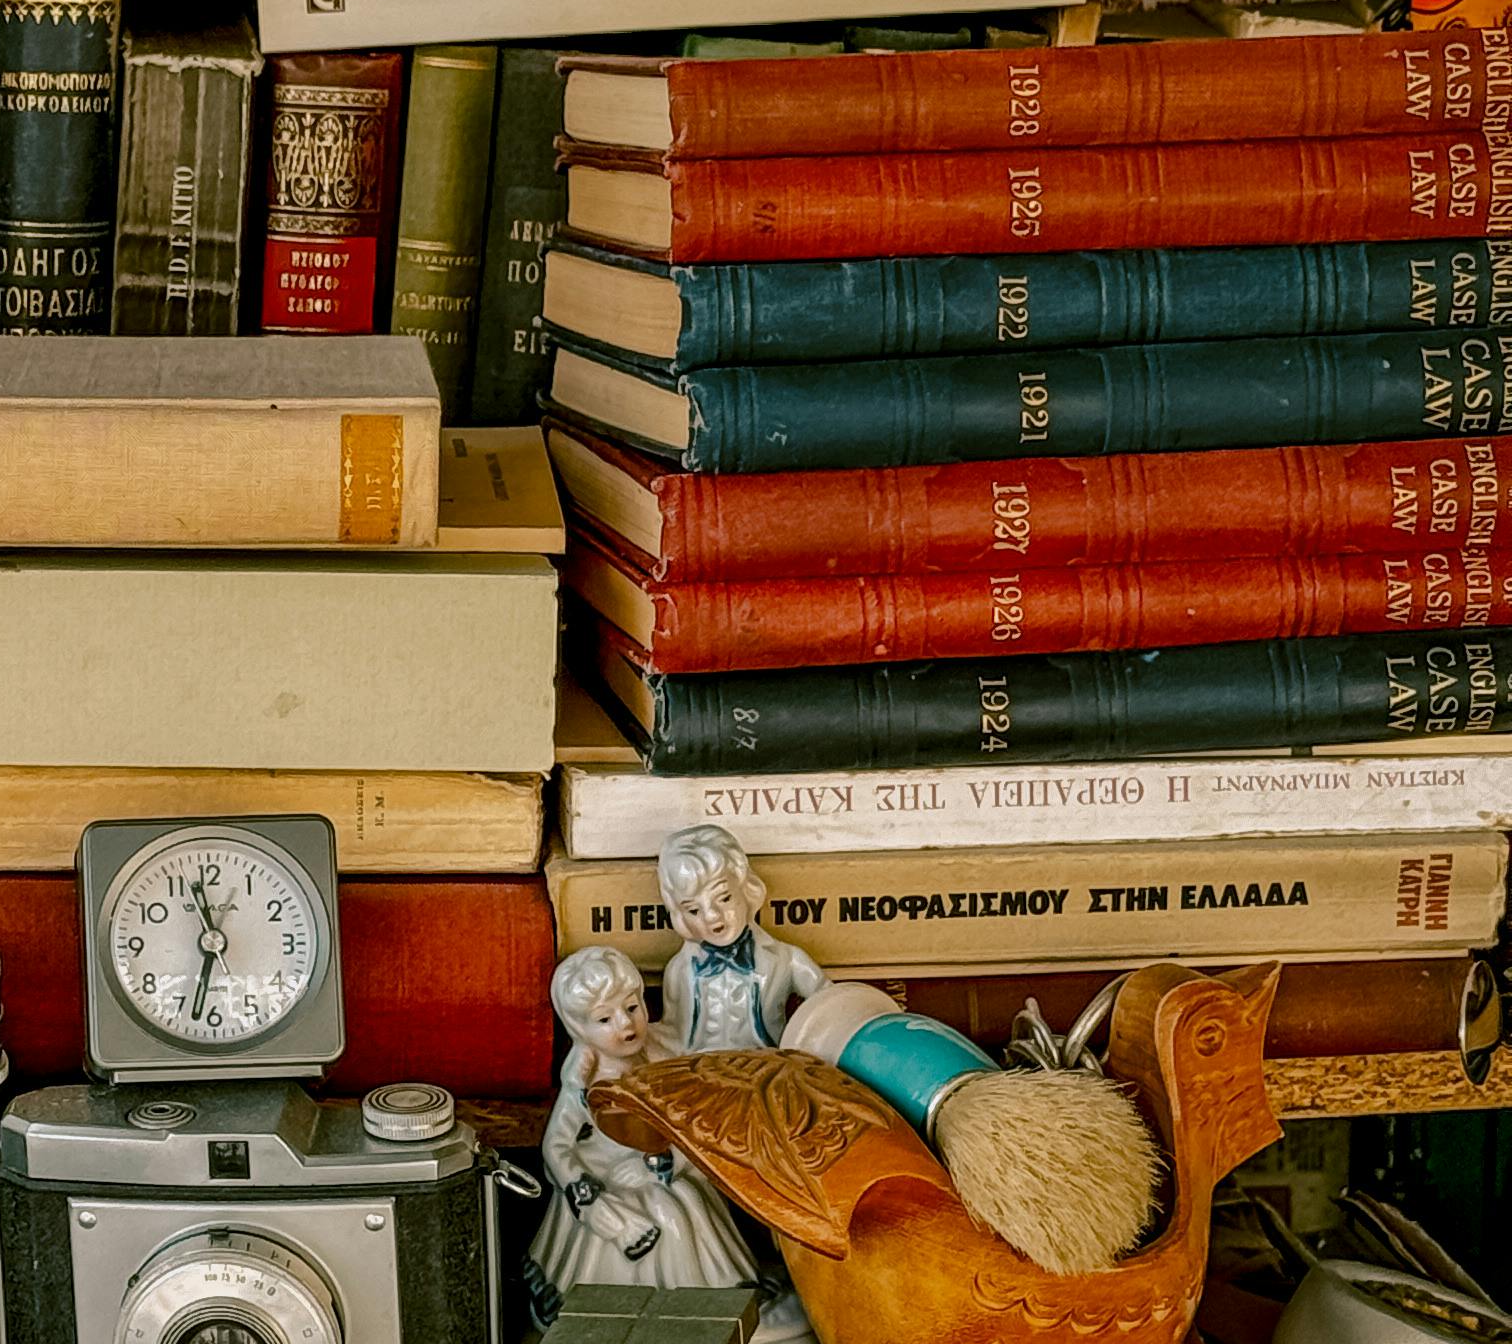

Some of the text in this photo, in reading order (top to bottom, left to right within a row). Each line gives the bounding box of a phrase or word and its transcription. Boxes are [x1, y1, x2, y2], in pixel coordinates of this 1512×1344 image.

[1009, 65, 1040, 136] 1928
[1403, 49, 1431, 120] LAW
[1444, 43, 1471, 119] CASE
[1008, 168, 1041, 236] 1925
[998, 275, 1028, 342] 1922
[1019, 371, 1046, 443] 1921
[992, 481, 1027, 554] 1927
[990, 576, 1023, 642] 1926
[979, 676, 1011, 753] 1924
[704, 769, 1466, 816] ΚΡΙΣΤΙΑΝ ΜΠΑΡΝΑΡΝΤ Η ΘΕΡΑΠΕΙΑ ΤΗΣ ΚΑΡΔΙΑΣ
[771, 882, 1309, 924] ΤΟΥ ΝΕΟΦΑΣΙΣΜΟΥ ΣΤΗΝ ΕΛΛΑΔΑ
